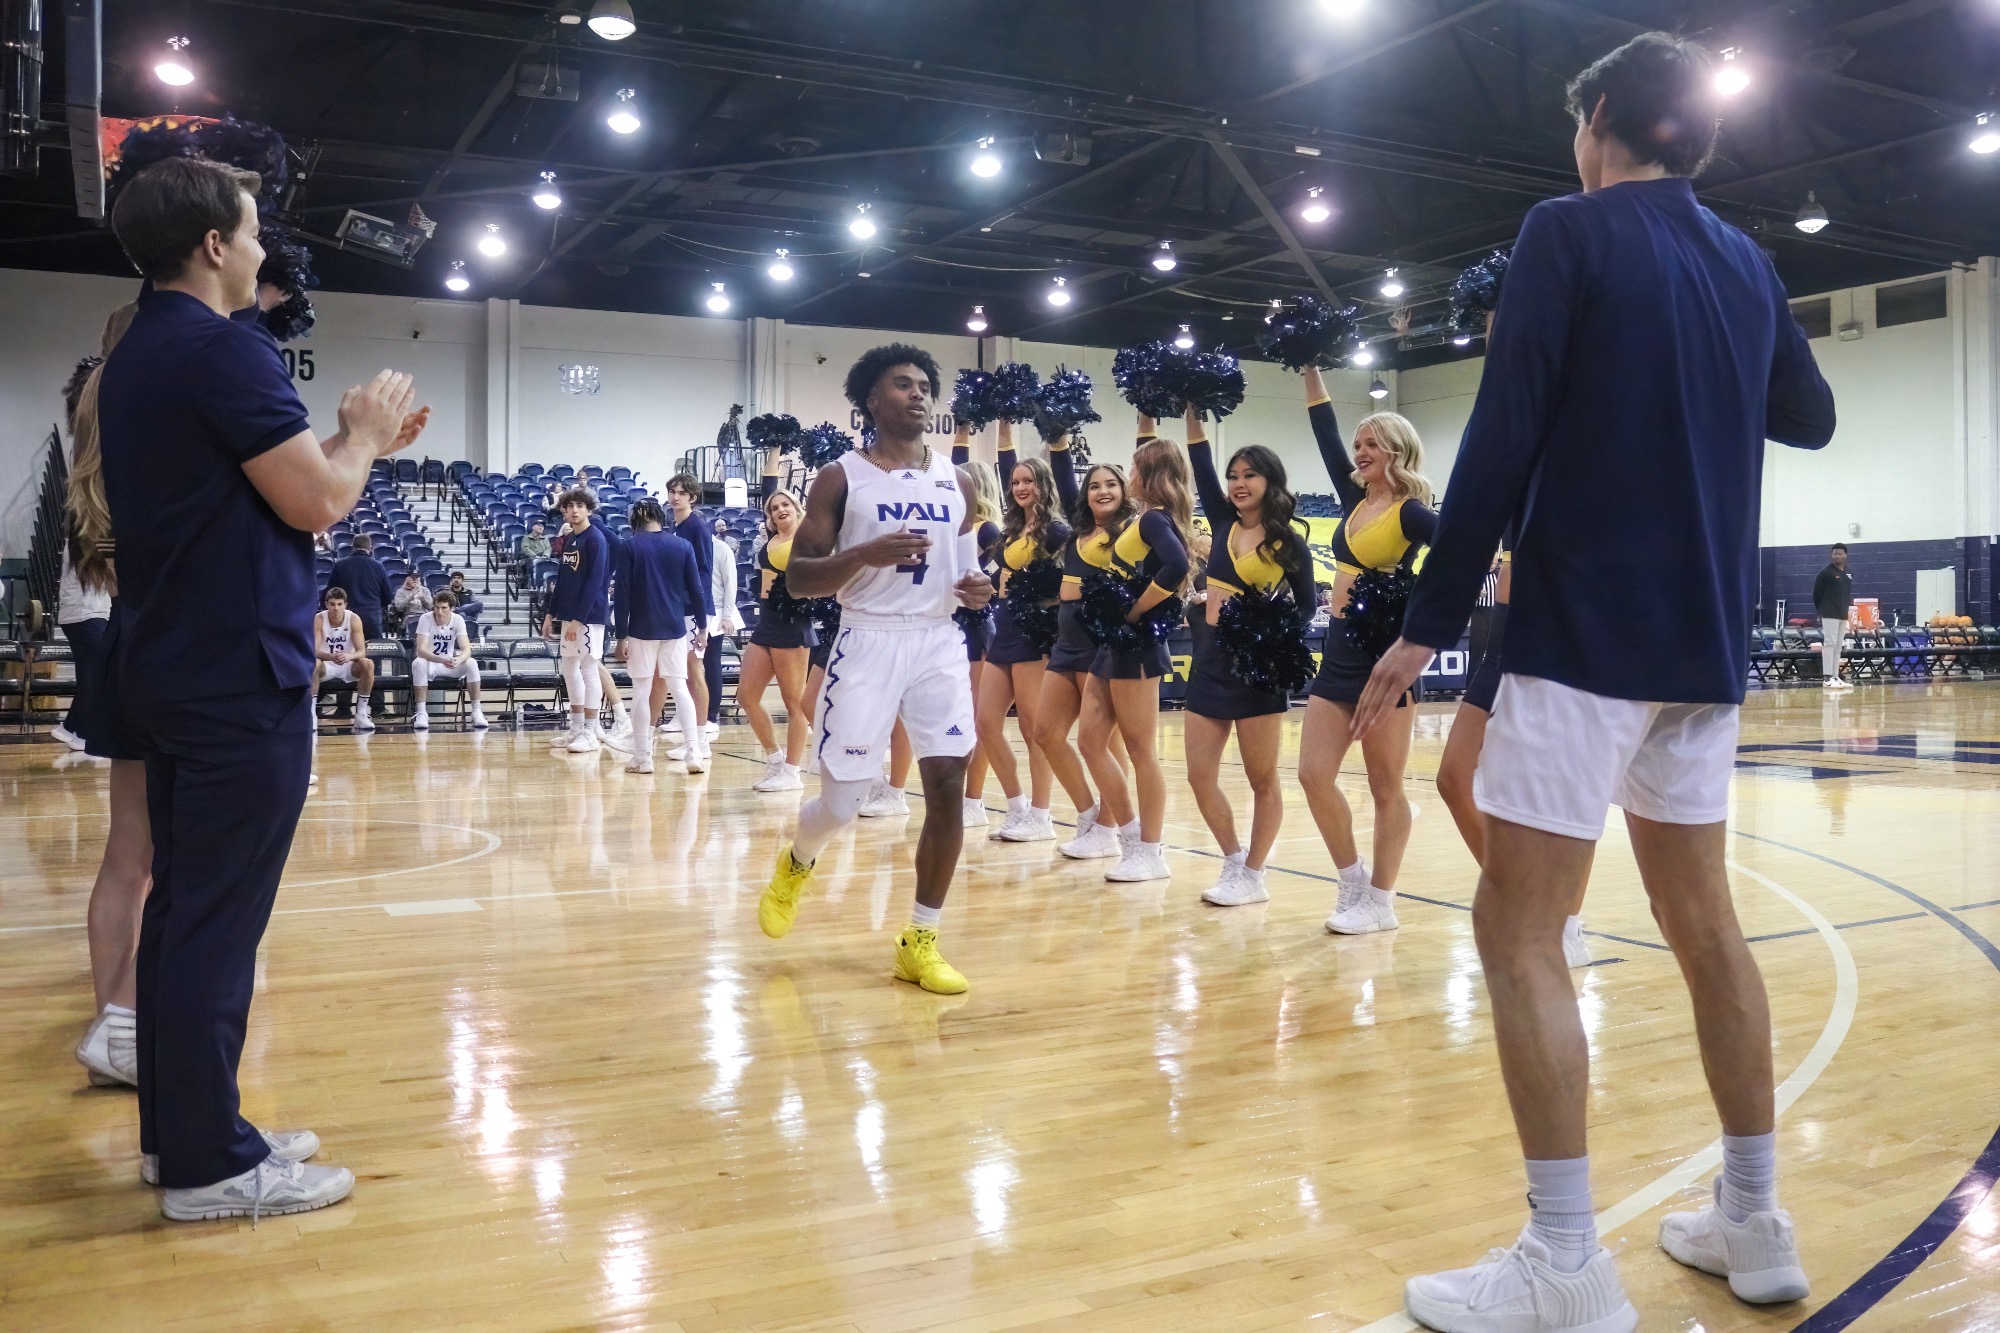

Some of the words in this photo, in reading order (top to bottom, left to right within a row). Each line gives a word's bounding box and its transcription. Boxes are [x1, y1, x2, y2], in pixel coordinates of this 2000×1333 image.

[281, 348, 315, 381] 05
[559, 364, 600, 395] 103
[876, 502, 951, 523] NAU
[432, 641, 448, 655] 24
